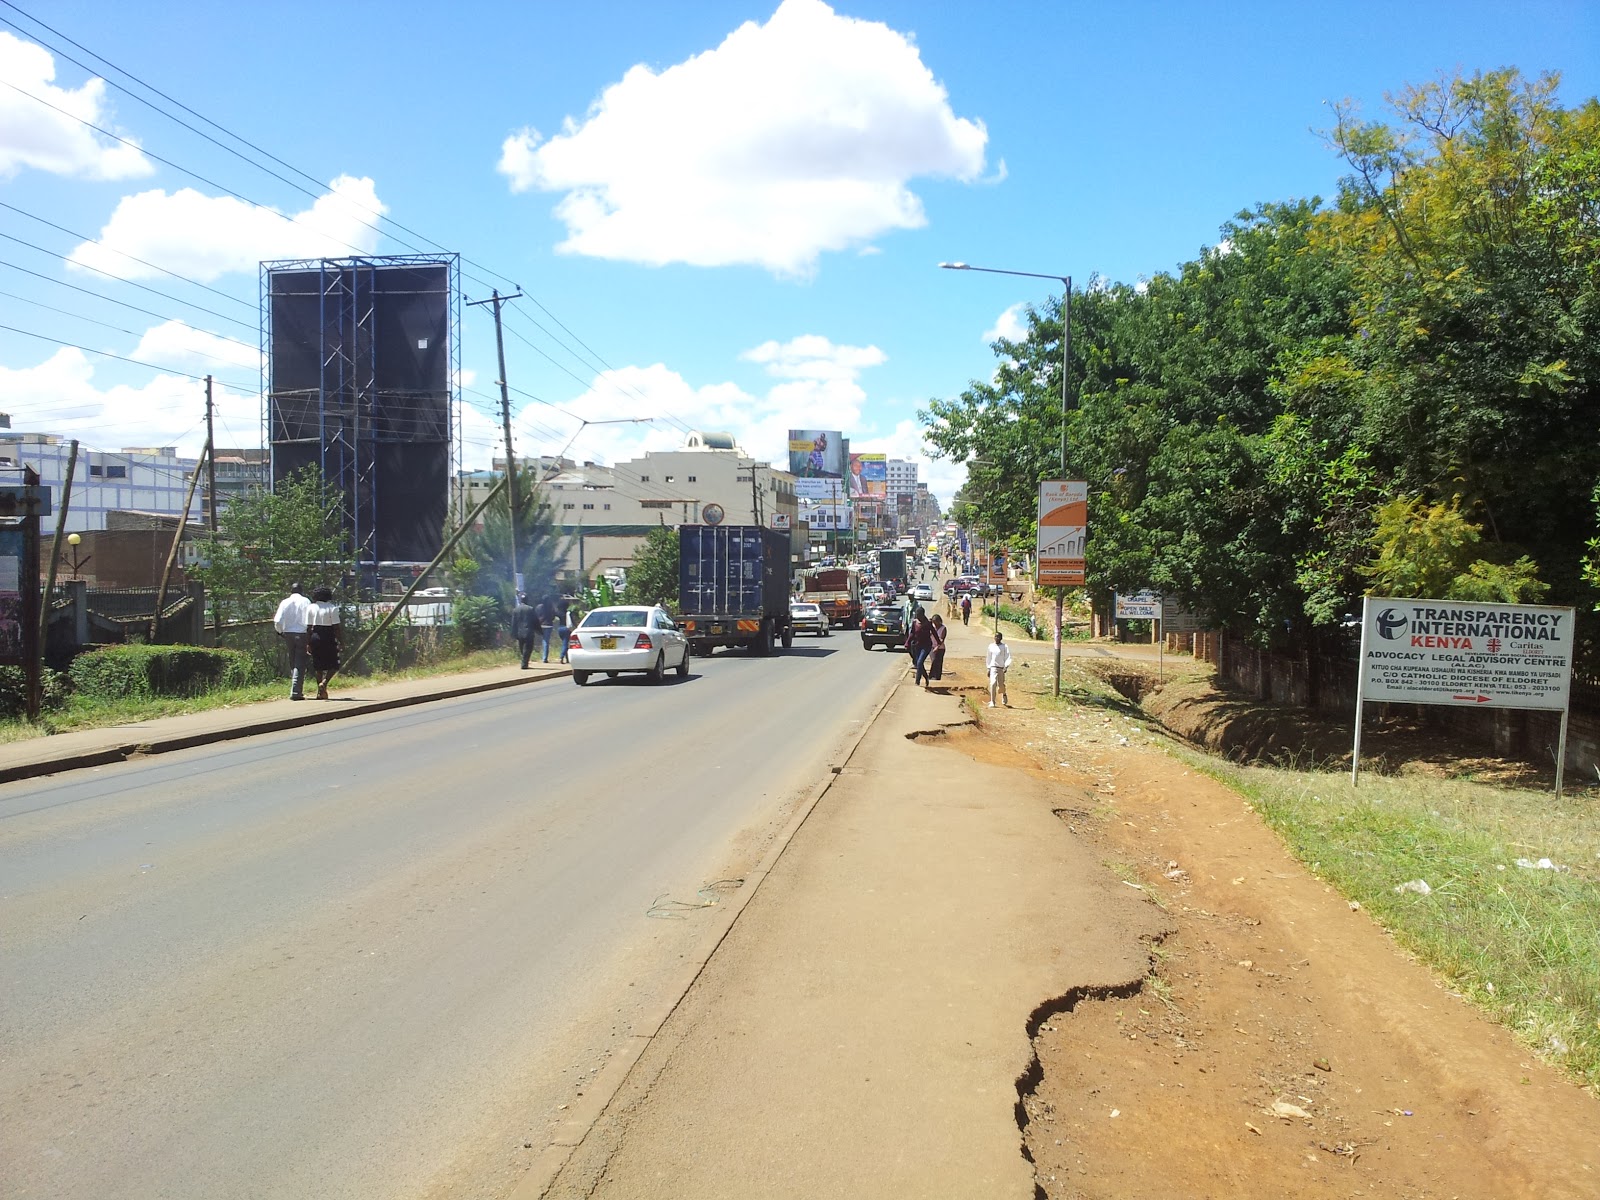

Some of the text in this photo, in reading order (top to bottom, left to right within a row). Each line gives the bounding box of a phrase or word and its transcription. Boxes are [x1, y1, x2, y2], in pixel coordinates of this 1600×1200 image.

[1413, 608, 1562, 626] TRANSPARENCY
[1411, 621, 1560, 640] INTERNATIONAL
[1411, 636, 1472, 650] KENYA
[1368, 651, 1566, 666] ADVOCACY LEGAL ADVISORY CENTRE
